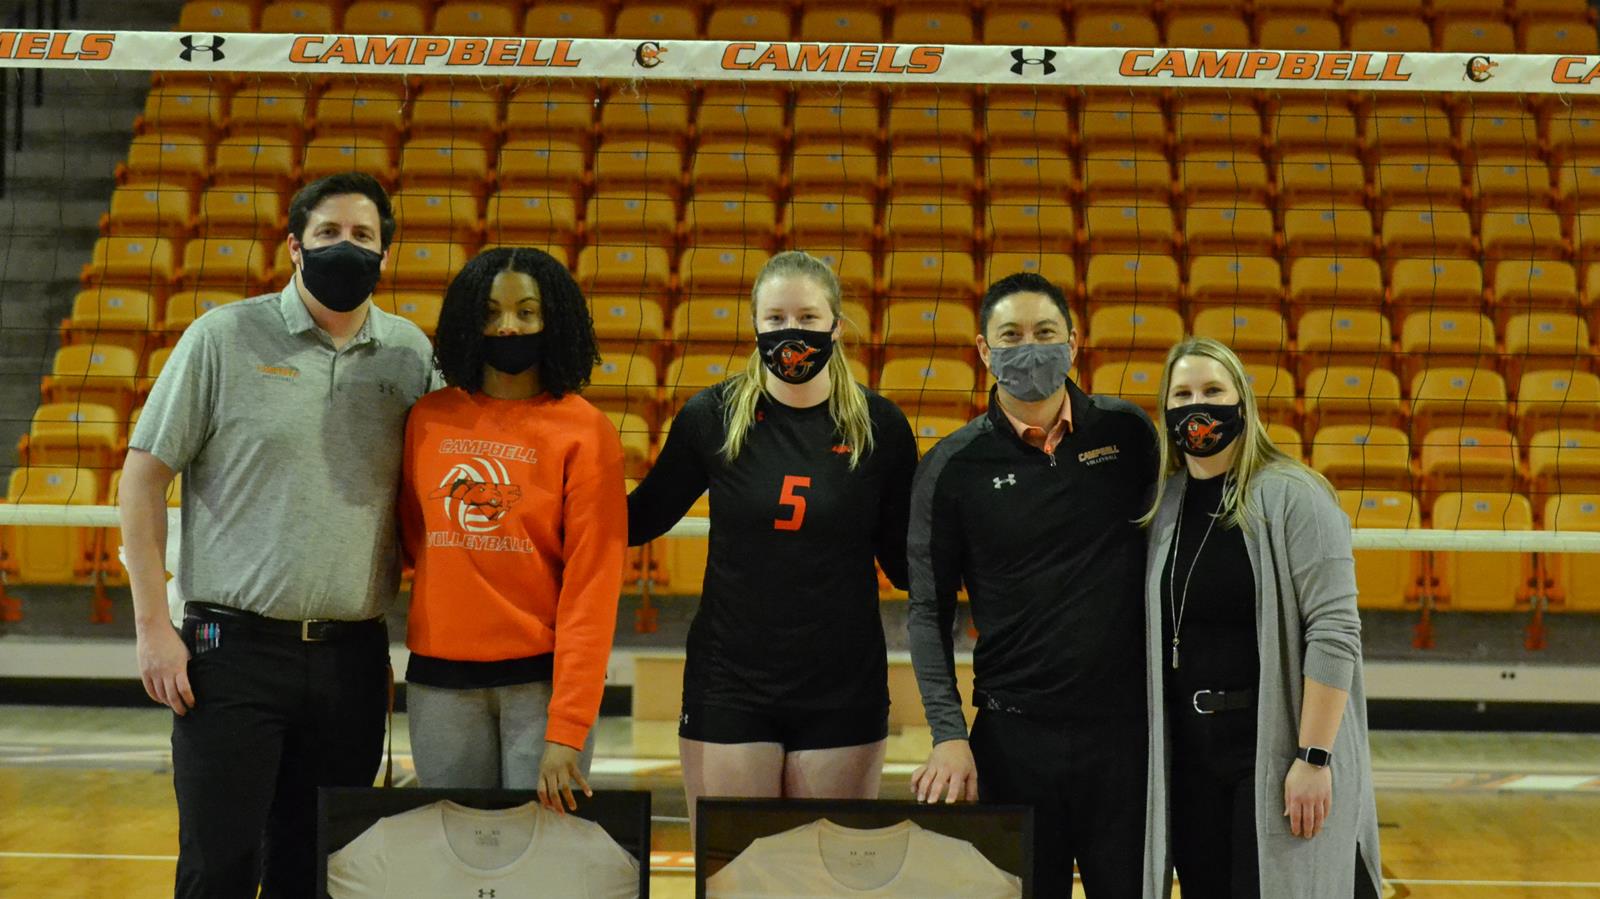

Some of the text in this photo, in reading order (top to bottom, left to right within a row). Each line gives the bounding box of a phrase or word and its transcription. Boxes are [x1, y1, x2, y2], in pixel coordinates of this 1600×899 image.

[288, 36, 582, 67] CAMPBELL
[721, 42, 945, 74] CAMELS
[1119, 49, 1412, 81] CAMPBELL
[438, 439, 538, 464] CAMPBELL
[774, 475, 812, 531] 5
[426, 531, 536, 554] VOLLEYBALL
